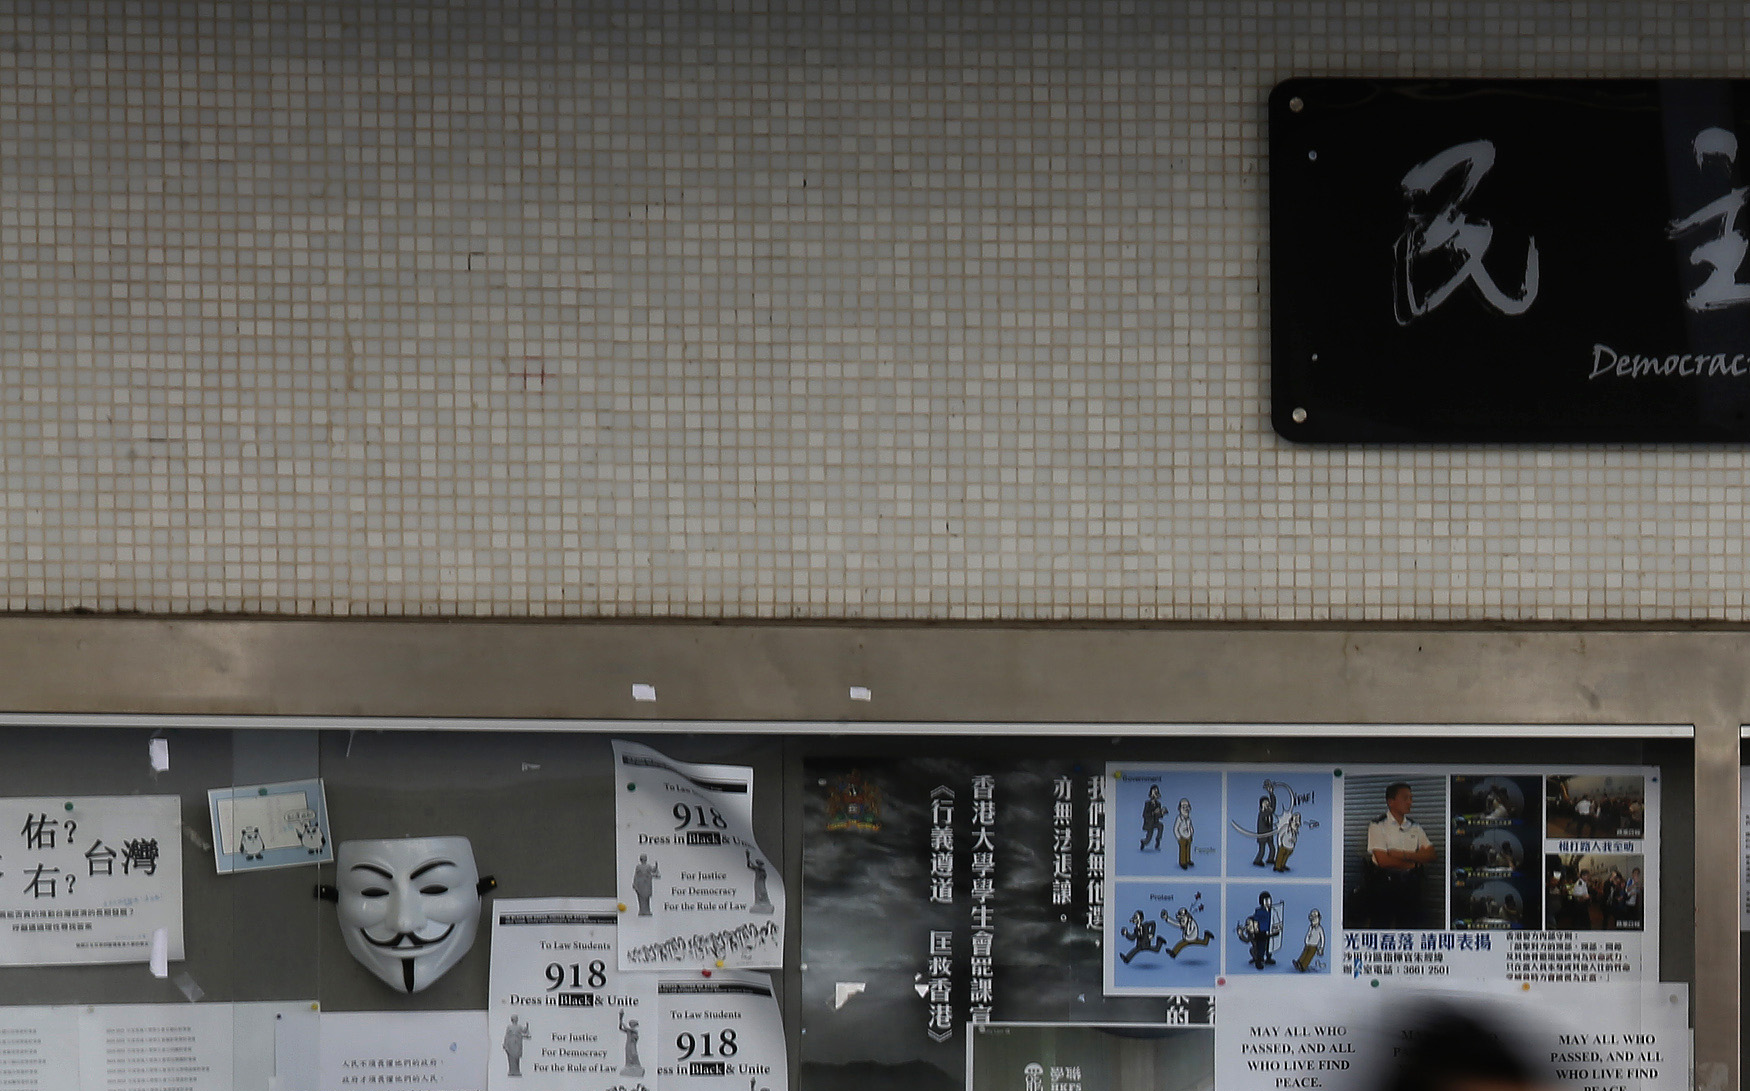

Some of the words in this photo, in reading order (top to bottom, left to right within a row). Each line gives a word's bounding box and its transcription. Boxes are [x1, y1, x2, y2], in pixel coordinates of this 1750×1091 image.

[672, 802, 728, 831] 918
[638, 834, 671, 845] Dress
[673, 834, 685, 844] in
[688, 833, 720, 845] Black
[721, 834, 731, 844] &
[83, 838, 160, 878] 台灣
[689, 886, 737, 897] Democracy
[540, 941, 551, 950] To
[553, 941, 571, 950] Law
[572, 941, 611, 950] Students
[1343, 932, 1415, 950] 光明磊落
[1420, 932, 1492, 951] 請即表揚
[545, 959, 607, 991] 918
[510, 995, 542, 1006] Dress
[545, 995, 557, 1005] in
[559, 994, 593, 1006] Black
[595, 995, 604, 1005] &
[607, 995, 639, 1006] Unite
[703, 1010, 742, 1020] Students
[1250, 1026, 1279, 1037] MAY
[1284, 1026, 1311, 1037] ALL
[1314, 1026, 1347, 1037] WHO
[552, 1033, 566, 1042] For
[568, 1033, 598, 1043] Justice
[1558, 1034, 1587, 1045] MAY
[1592, 1034, 1620, 1045] ALL
[1622, 1034, 1656, 1045] WHO
[676, 1028, 739, 1062] 918
[1241, 1042, 1295, 1056] PASSED,
[1298, 1042, 1327, 1054] AND
[1330, 1042, 1356, 1054] ALL
[541, 1049, 557, 1057] For
[559, 1048, 608, 1059] Democracy
[1550, 1051, 1604, 1064] PASSED,
[1606, 1051, 1635, 1062] AND
[1638, 1051, 1664, 1062] ALL
[534, 1064, 550, 1072] For
[552, 1064, 565, 1072] the
[567, 1064, 588, 1072] Rule
[589, 1064, 599, 1072] of
[600, 1064, 618, 1073] Law
[675, 1064, 688, 1074] in
[691, 1063, 724, 1075] Black
[726, 1064, 735, 1074] &
[737, 1063, 770, 1075] Unite
[1247, 1059, 1280, 1071] WHO
[1284, 1059, 1315, 1071] LIVE
[1318, 1059, 1350, 1071] FIND
[1556, 1068, 1589, 1080] WHO
[1592, 1068, 1623, 1080] LIVE
[1626, 1068, 1659, 1080] FIND
[1275, 1076, 1322, 1088] PEACE.
